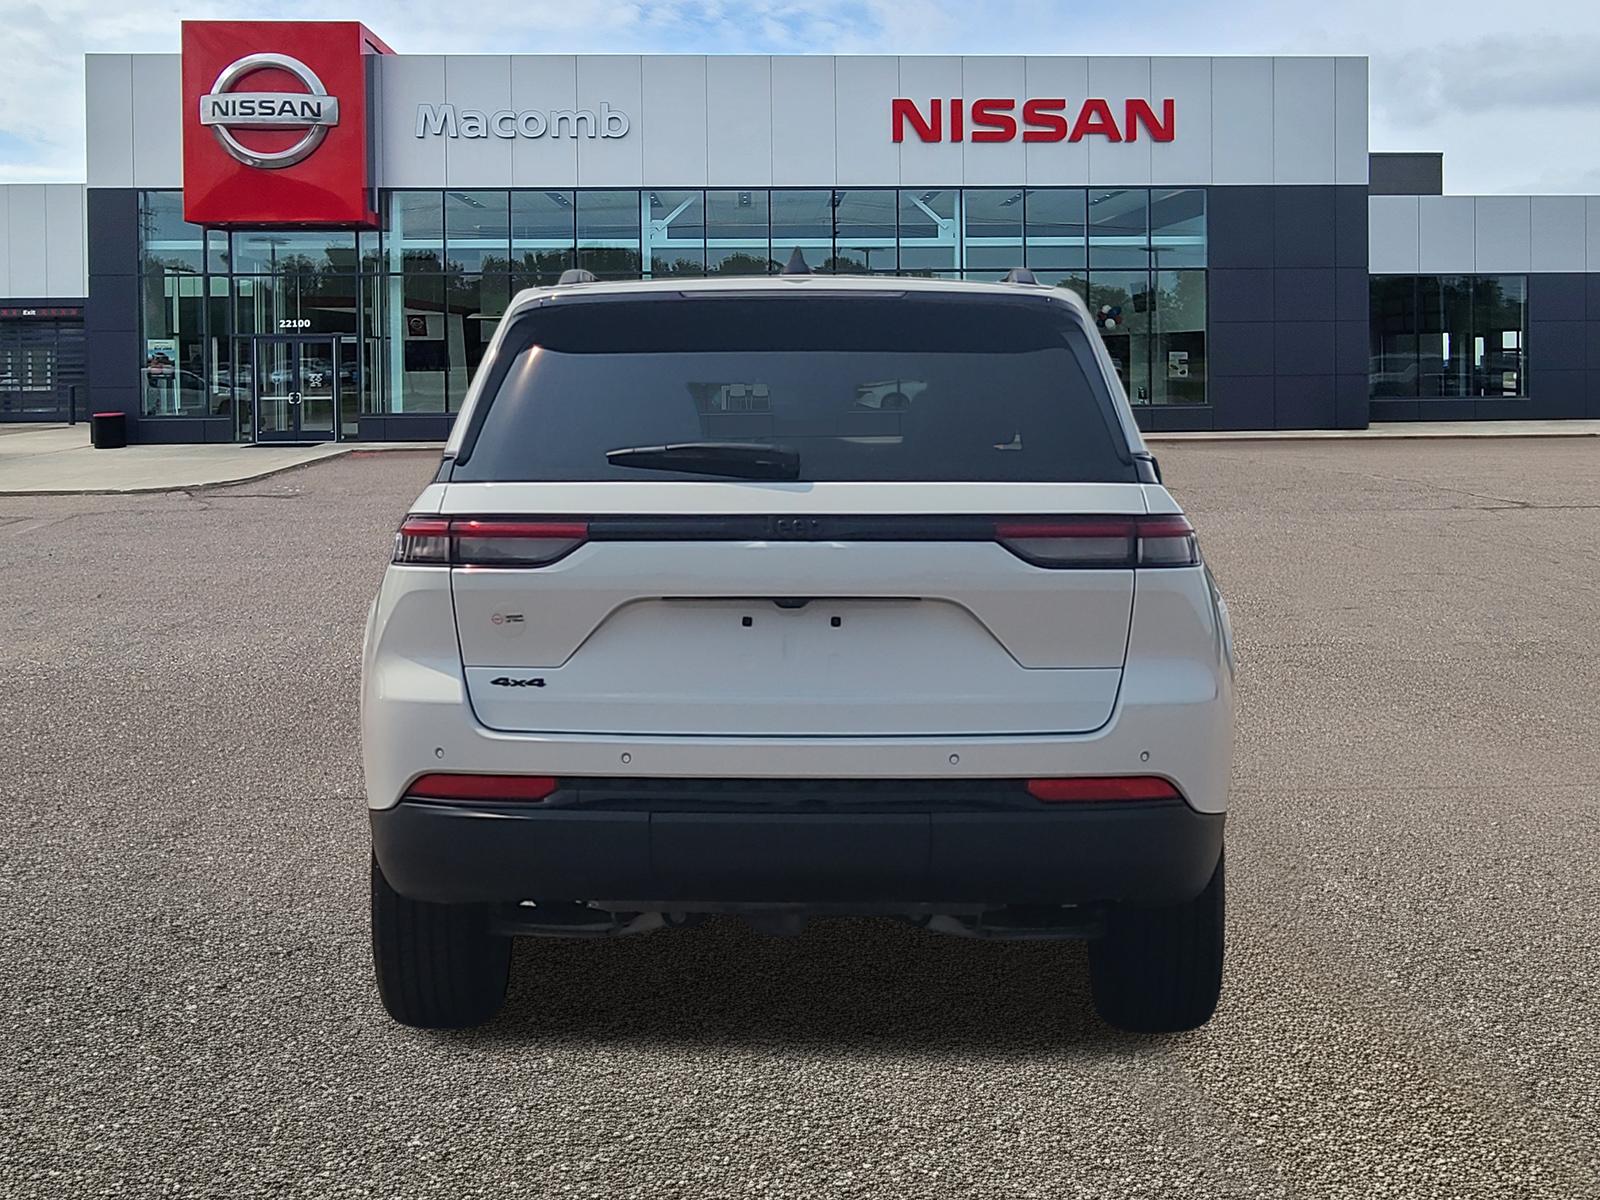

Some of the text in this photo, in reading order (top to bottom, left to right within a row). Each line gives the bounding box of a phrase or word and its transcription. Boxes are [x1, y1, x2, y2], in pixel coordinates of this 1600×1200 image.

[212, 100, 322, 117] NISSAN
[415, 102, 630, 139] Macomb
[892, 98, 1175, 143] NISSAN
[279, 319, 311, 328] 22100
[490, 677, 546, 687] 4x4
